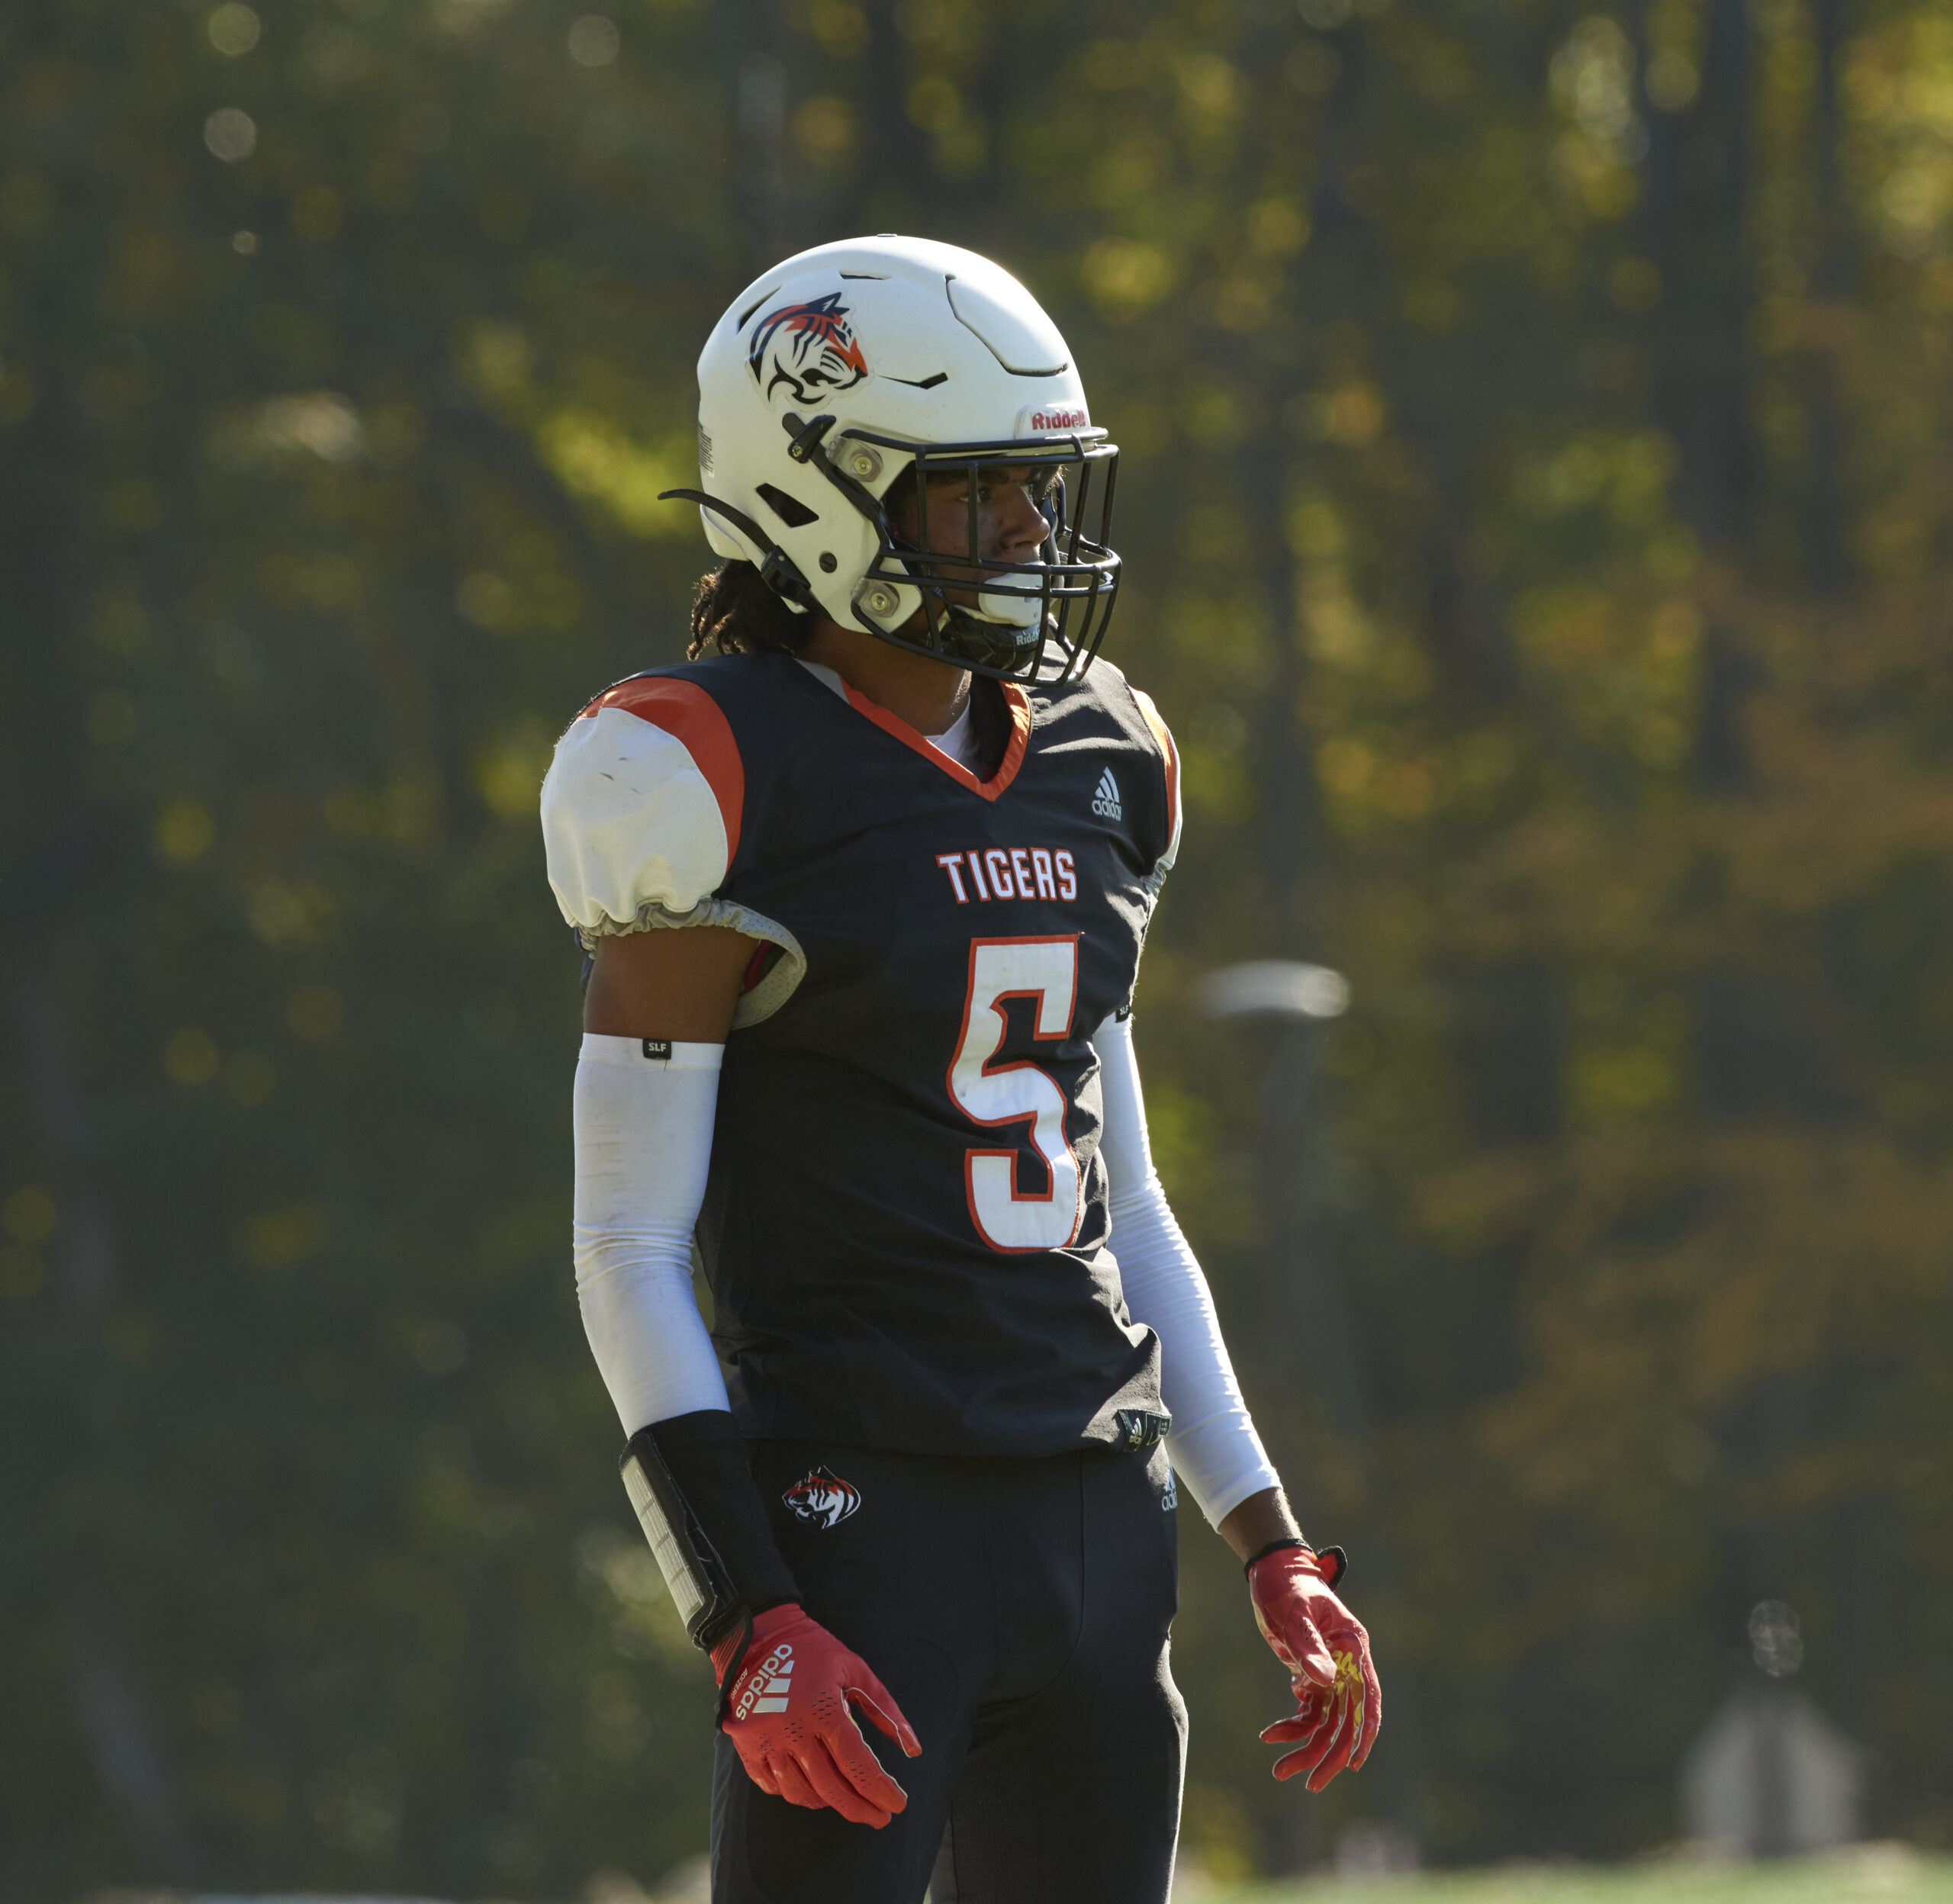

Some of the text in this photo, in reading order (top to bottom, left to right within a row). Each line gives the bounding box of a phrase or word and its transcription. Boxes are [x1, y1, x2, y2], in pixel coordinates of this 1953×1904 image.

[935, 847, 1078, 904] TIGERS
[648, 1042, 667, 1052] SLF
[946, 934, 1079, 1253] 5
[731, 1668, 748, 1700] ADIZERO
[735, 1644, 793, 1721] adidas
